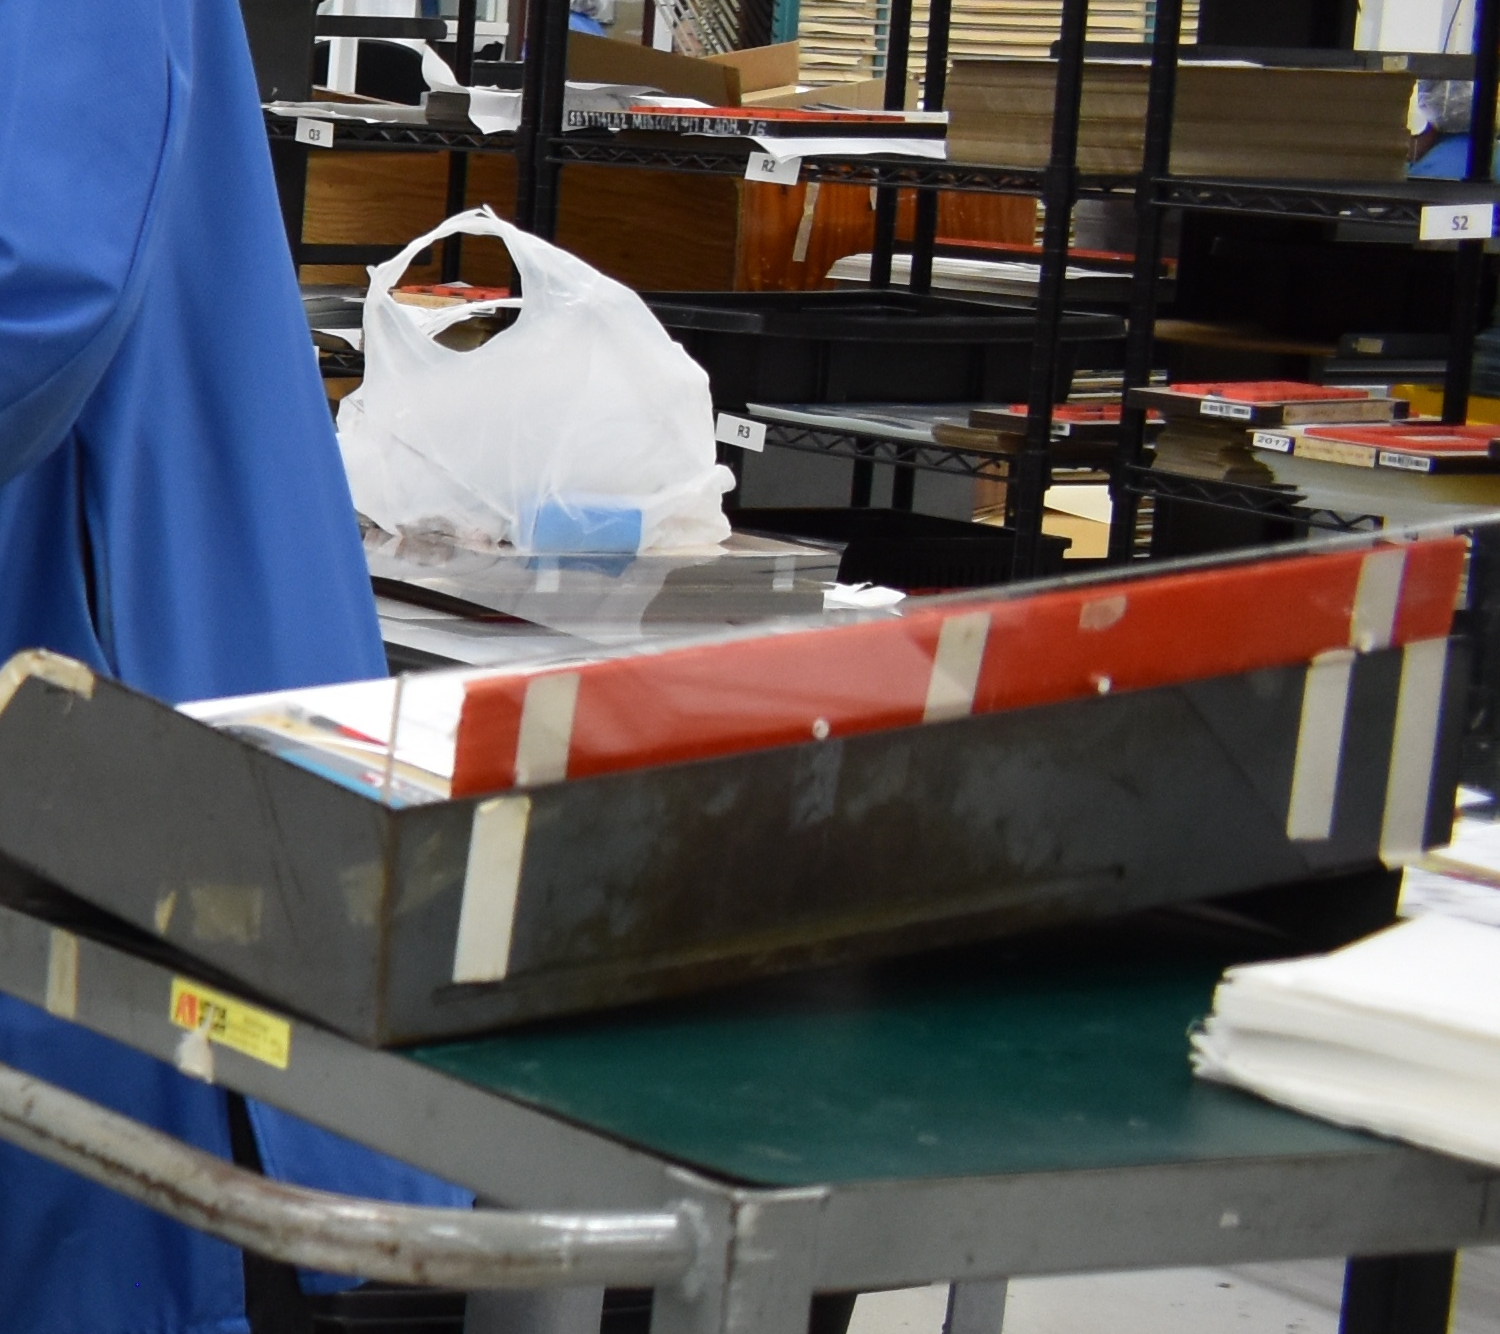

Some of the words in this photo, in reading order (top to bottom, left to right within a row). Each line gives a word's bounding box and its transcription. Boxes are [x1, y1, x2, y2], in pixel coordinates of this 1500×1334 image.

[307, 127, 321, 140] Q3
[761, 159, 776, 173] R2
[1452, 215, 1469, 231] S2
[737, 425, 751, 439] R3
